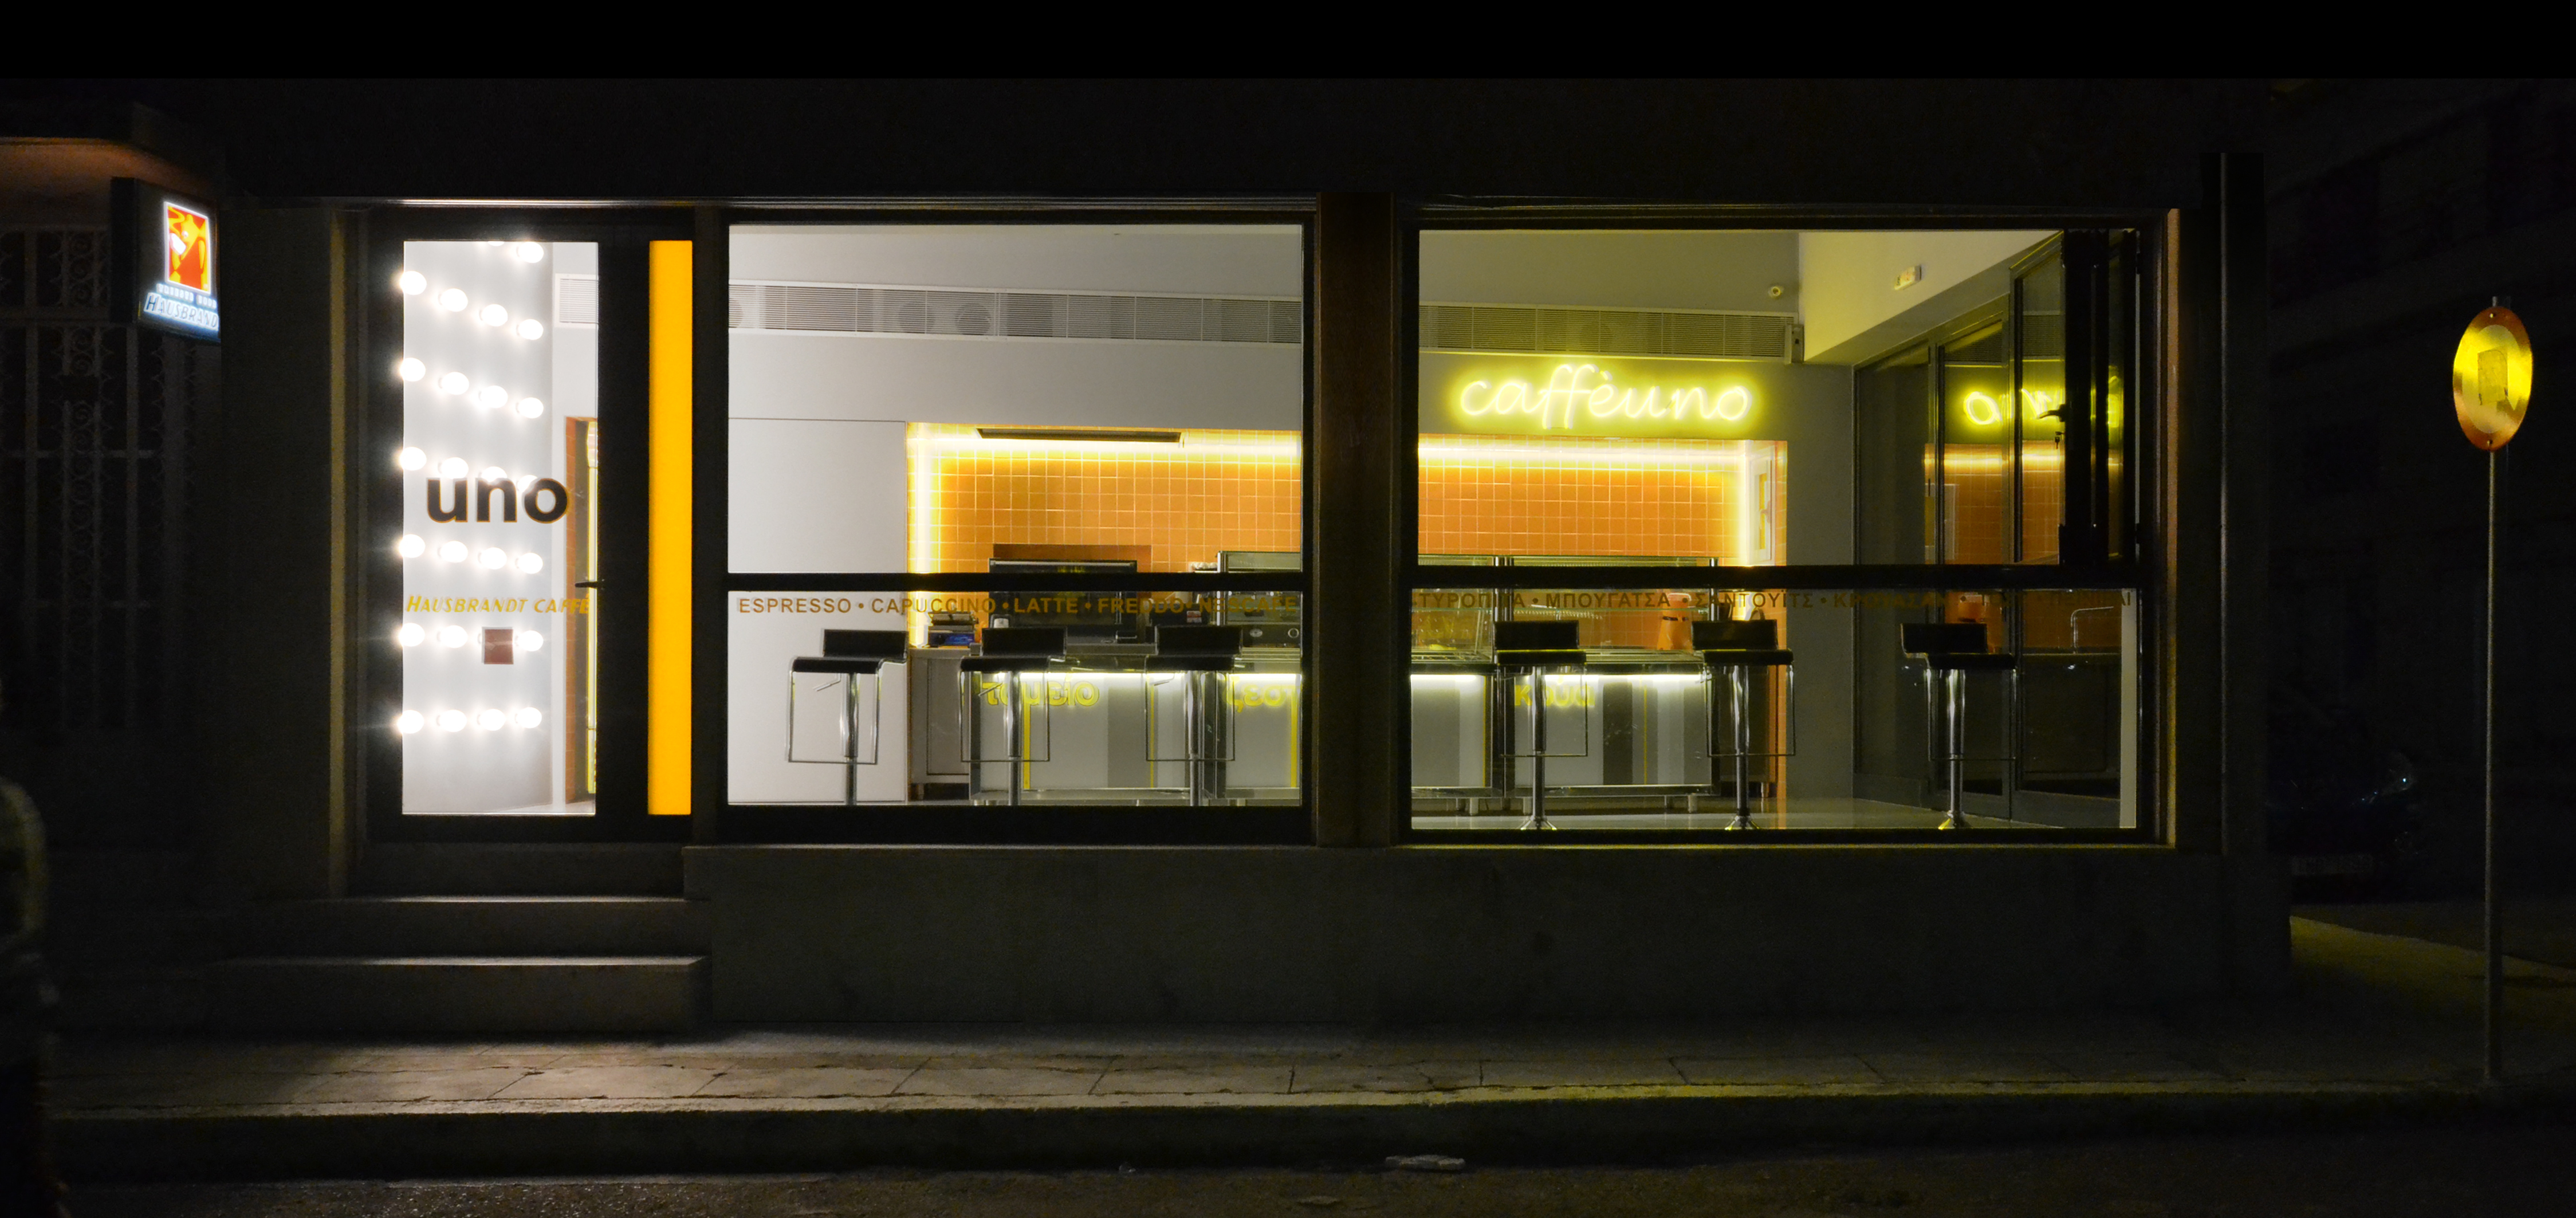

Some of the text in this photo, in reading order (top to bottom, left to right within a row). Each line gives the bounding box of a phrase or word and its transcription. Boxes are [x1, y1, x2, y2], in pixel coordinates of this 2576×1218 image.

[427, 477, 569, 524] uno
[406, 595, 529, 613] HAUSBRANDT
[739, 598, 852, 614] ESPRESSO
[871, 598, 997, 614] CAPUCCINO
[1014, 598, 1078, 614] LATTE
[1098, 598, 1184, 614] FREDDO
[1546, 592, 1671, 608] ΜΠΟΥΓΑΤΣΑ
